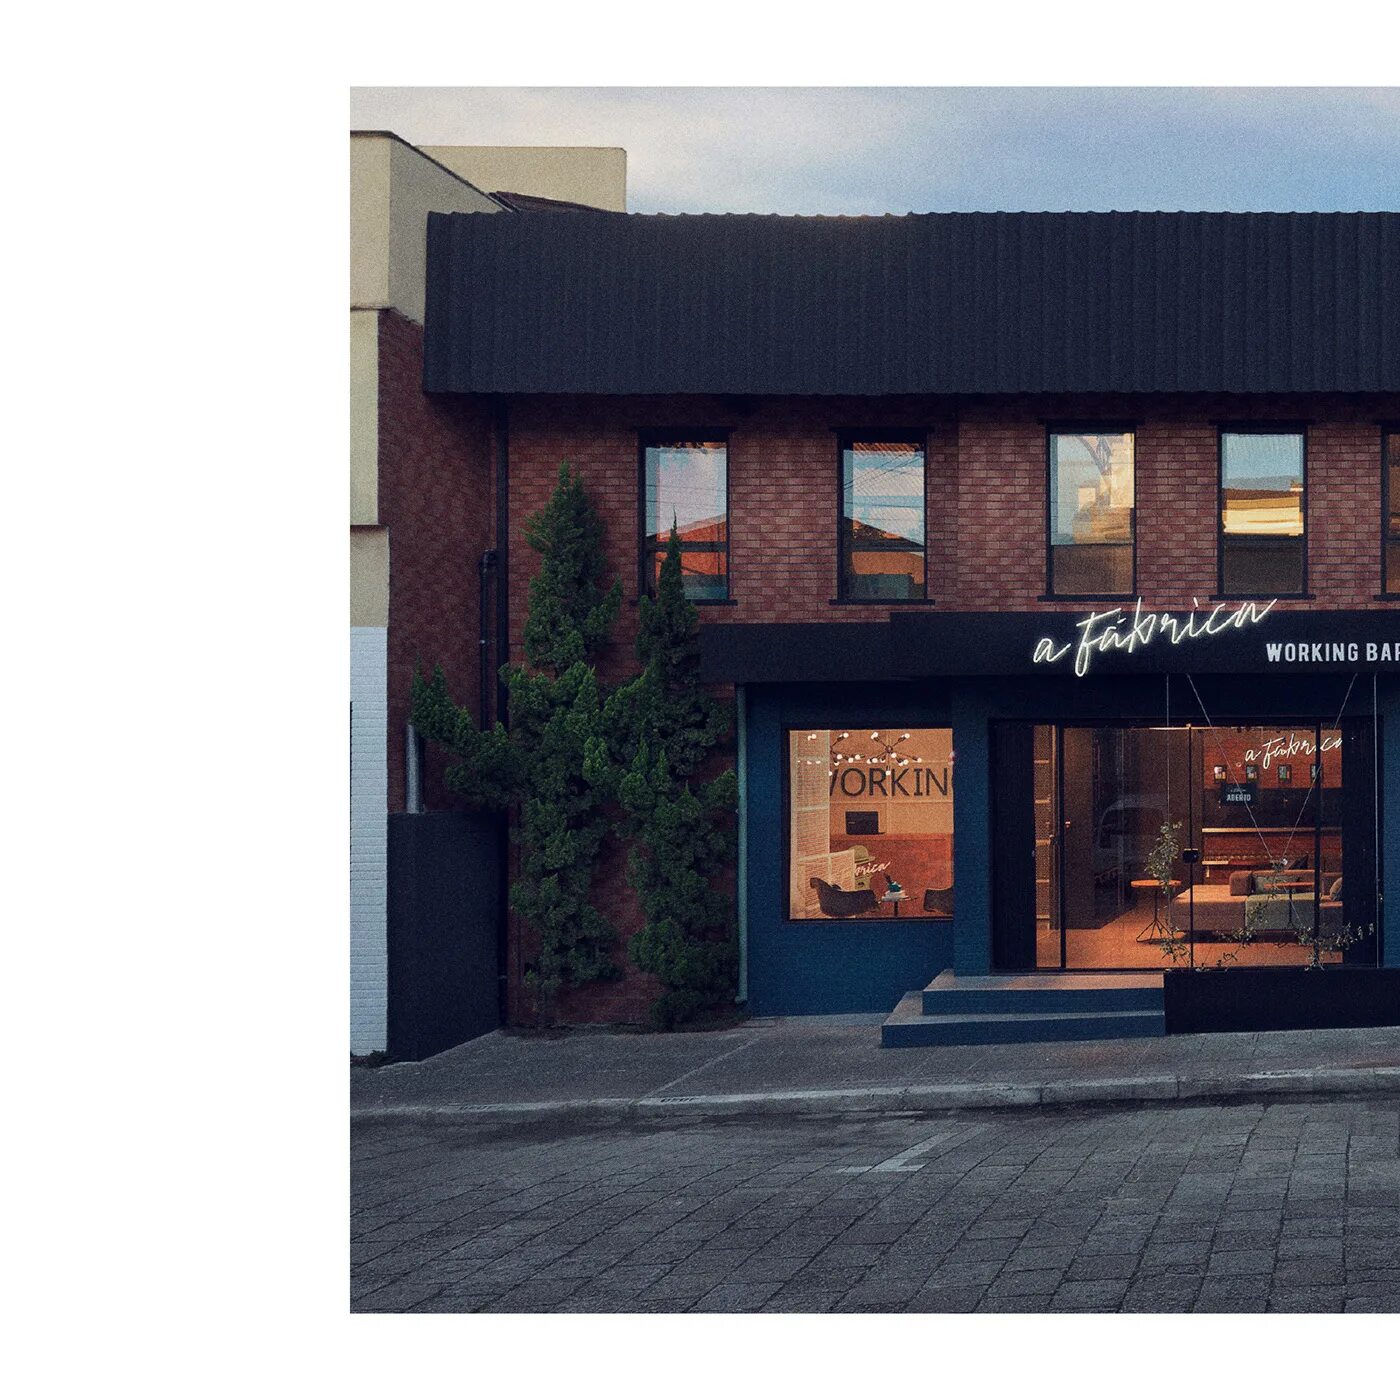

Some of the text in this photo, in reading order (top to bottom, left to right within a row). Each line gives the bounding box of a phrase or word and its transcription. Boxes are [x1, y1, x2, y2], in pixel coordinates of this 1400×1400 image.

[1033, 637, 1071, 663] a
[1265, 642, 1359, 663] WORKING
[1244, 749, 1262, 762] a
[830, 767, 953, 797] ORKIN
